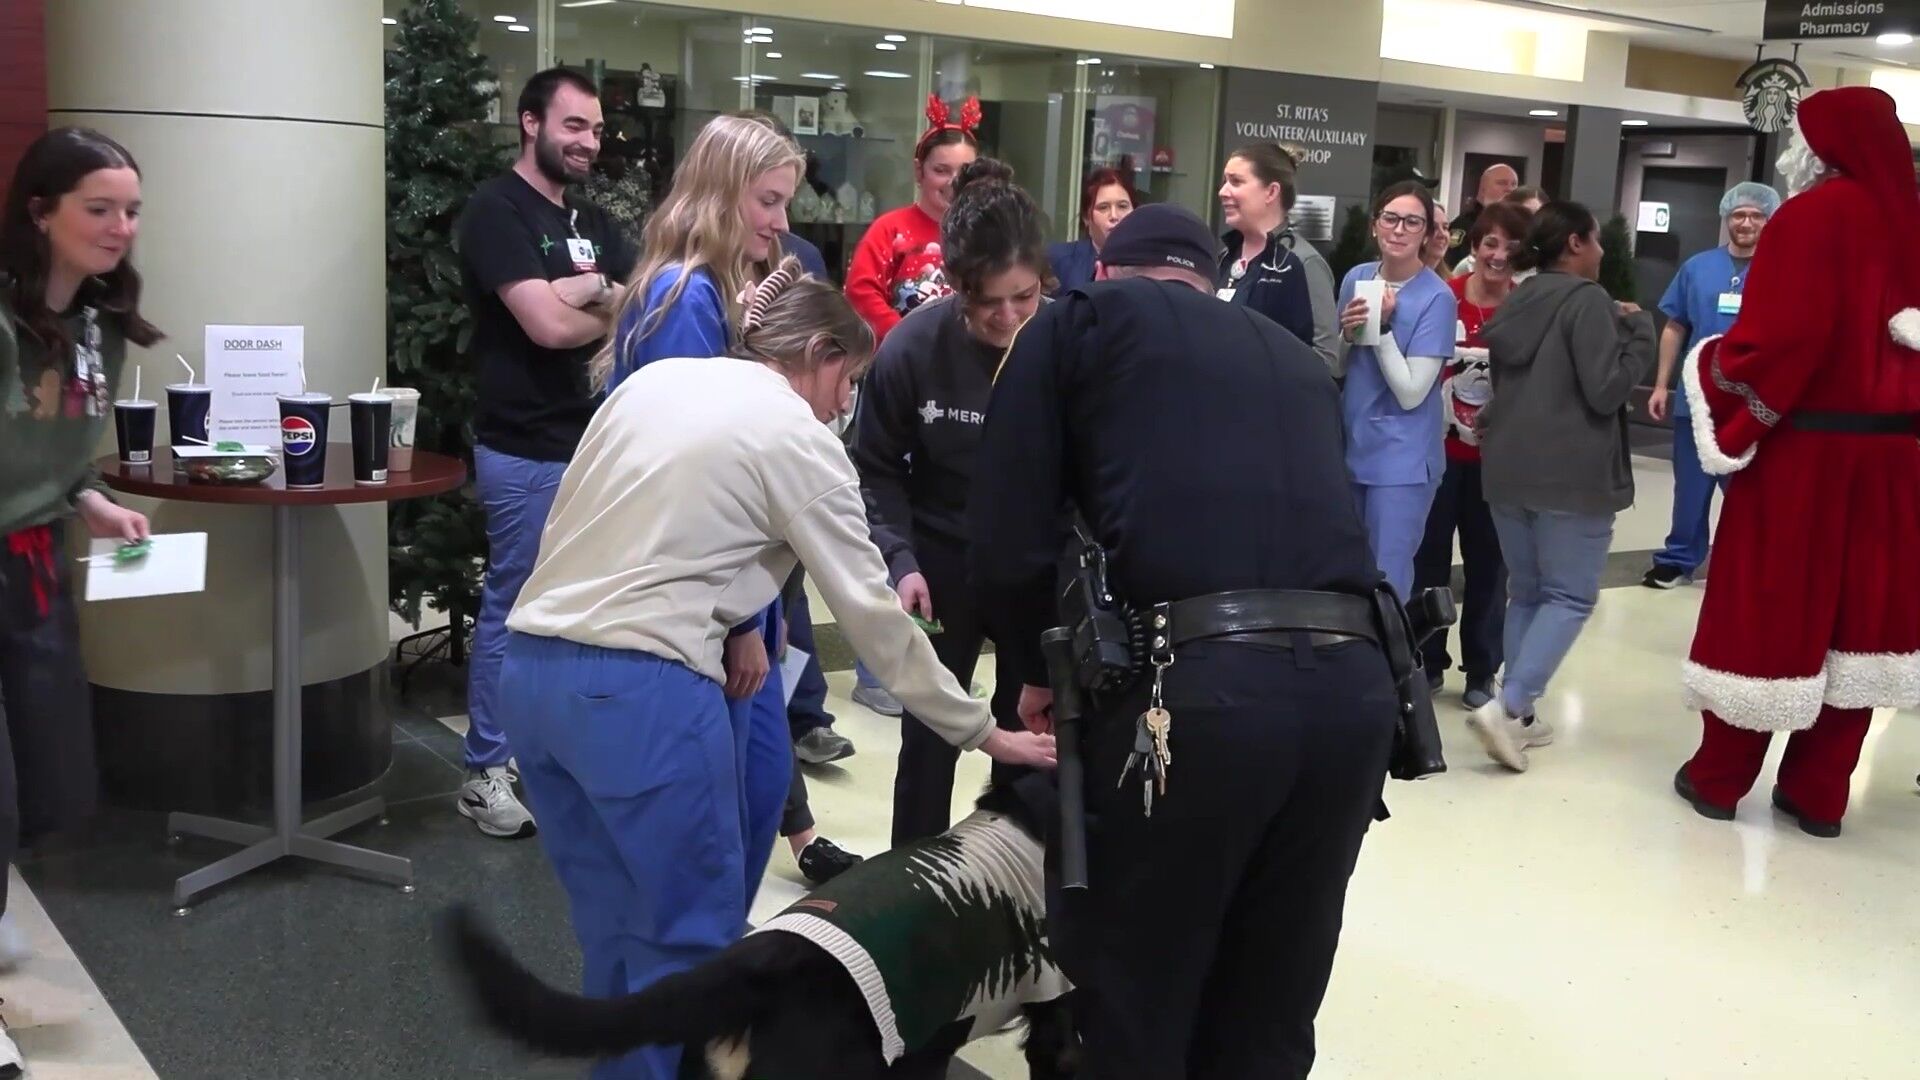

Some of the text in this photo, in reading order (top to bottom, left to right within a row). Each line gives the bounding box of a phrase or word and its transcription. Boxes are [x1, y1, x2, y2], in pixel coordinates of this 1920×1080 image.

[1801, 2, 1884, 17] Admissions
[1799, 21, 1870, 35] Pharmacy
[1277, 104, 1329, 122] ST. RITA'S
[1236, 122, 1367, 146] VOLUNTEER/AUXILIARY
[1166, 254, 1195, 269] POLICE
[223, 339, 282, 350] DOOR DASH
